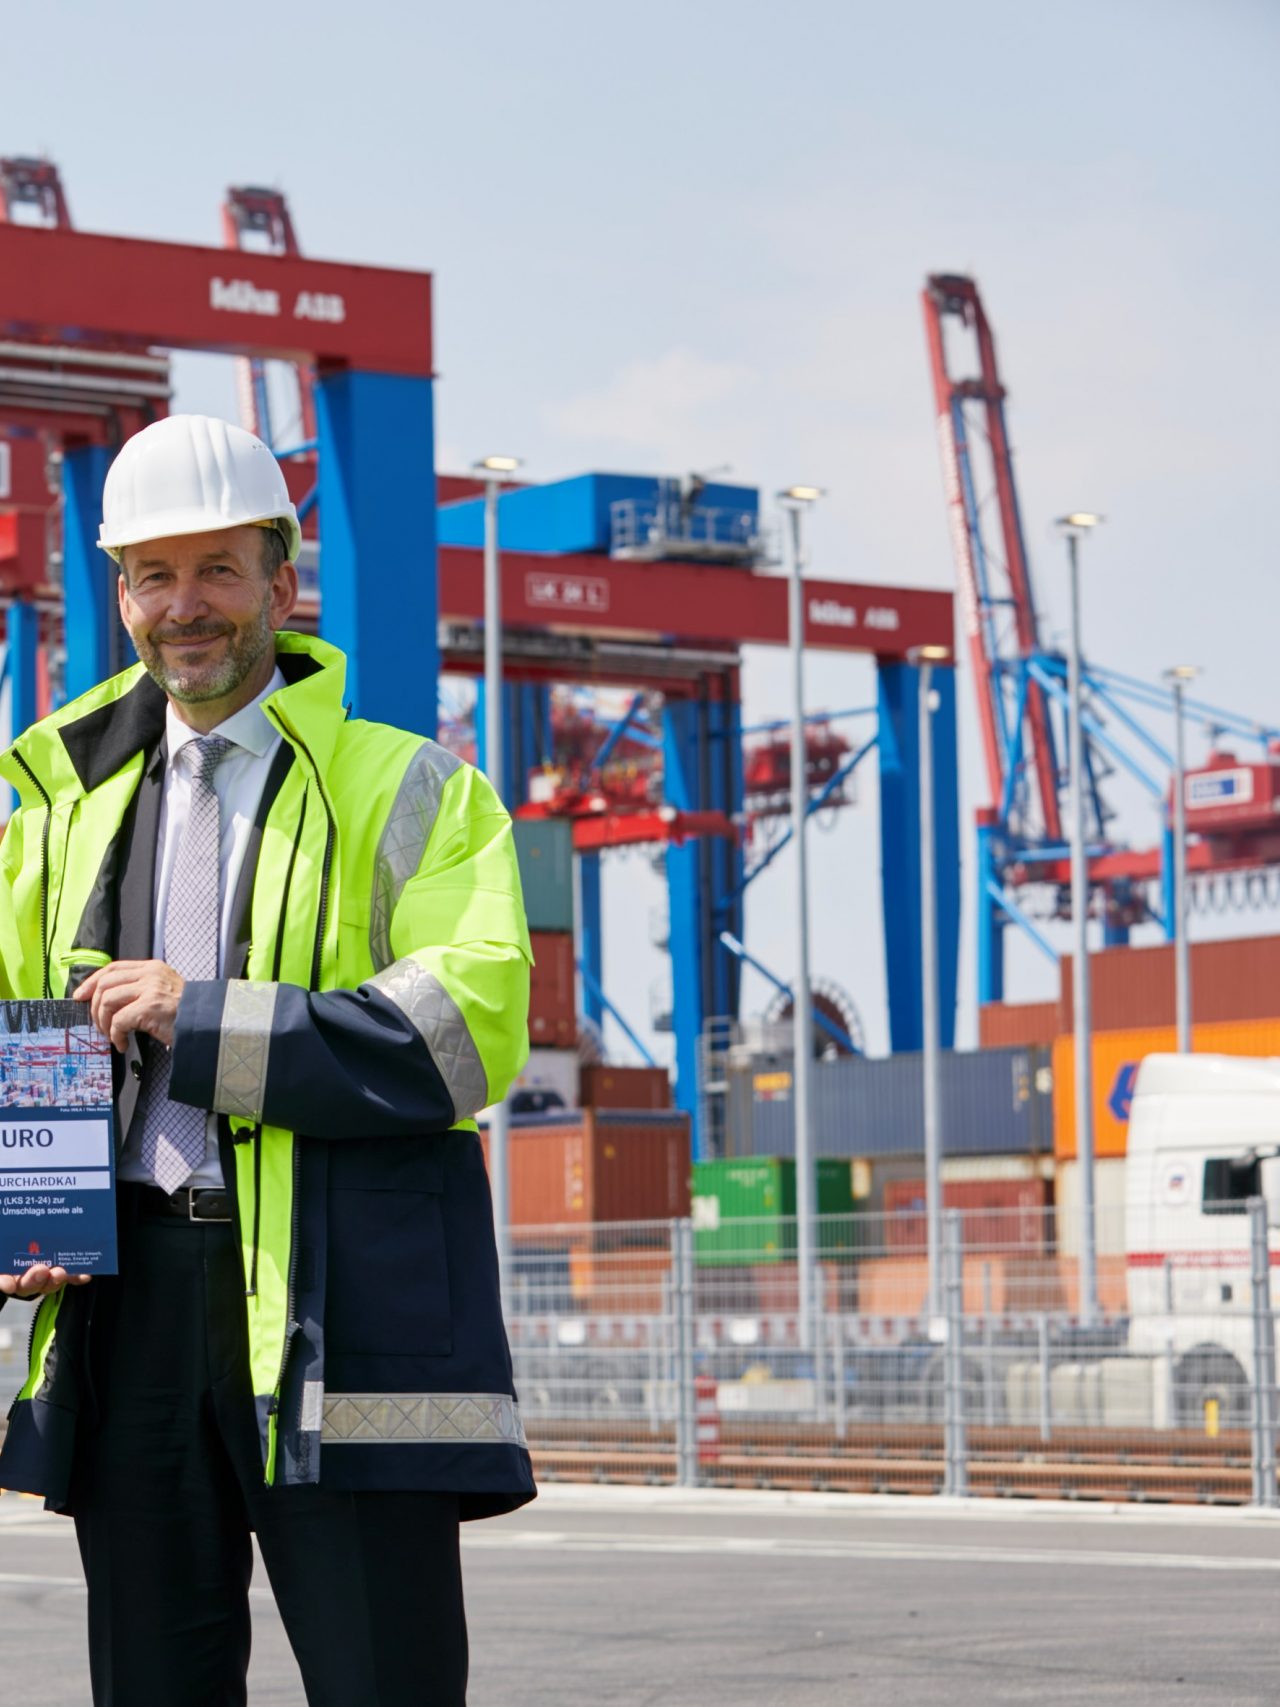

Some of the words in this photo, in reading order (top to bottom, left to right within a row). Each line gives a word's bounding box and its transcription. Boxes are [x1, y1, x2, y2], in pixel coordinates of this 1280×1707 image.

[294, 291, 345, 323] ABB
[4, 1197, 23, 1206] (LKS
[25, 1196, 51, 1205] 21-24)
[2, 1207, 45, 1216] Umschlags
[72, 1206, 83, 1214] als
[13, 1259, 52, 1267] Hamburg
